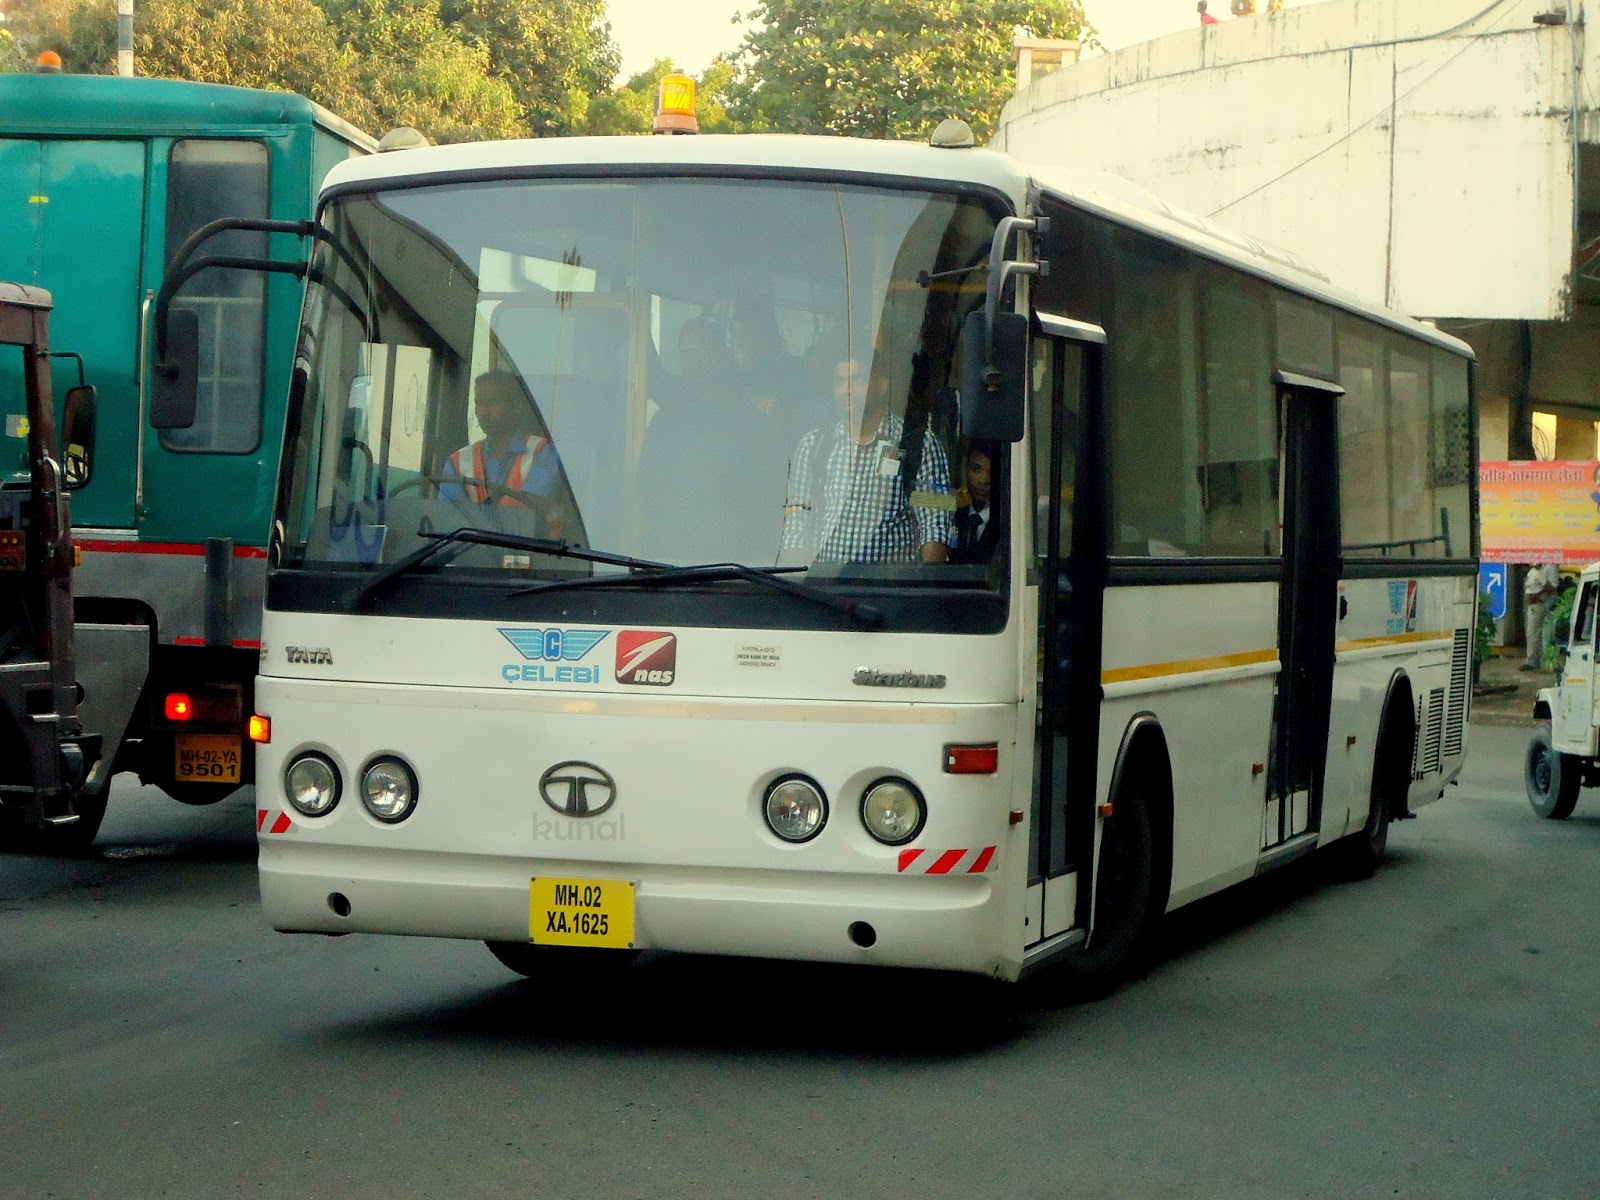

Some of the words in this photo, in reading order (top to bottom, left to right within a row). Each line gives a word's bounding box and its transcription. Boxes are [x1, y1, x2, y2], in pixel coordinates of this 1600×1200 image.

[285, 645, 333, 665] TATA
[634, 668, 672, 683] nas
[852, 666, 947, 689] Starbus
[180, 749, 237, 763] MH-02-YA
[179, 763, 236, 777] 9501
[555, 884, 602, 908] MH.02
[546, 911, 608, 935] XA.1625
